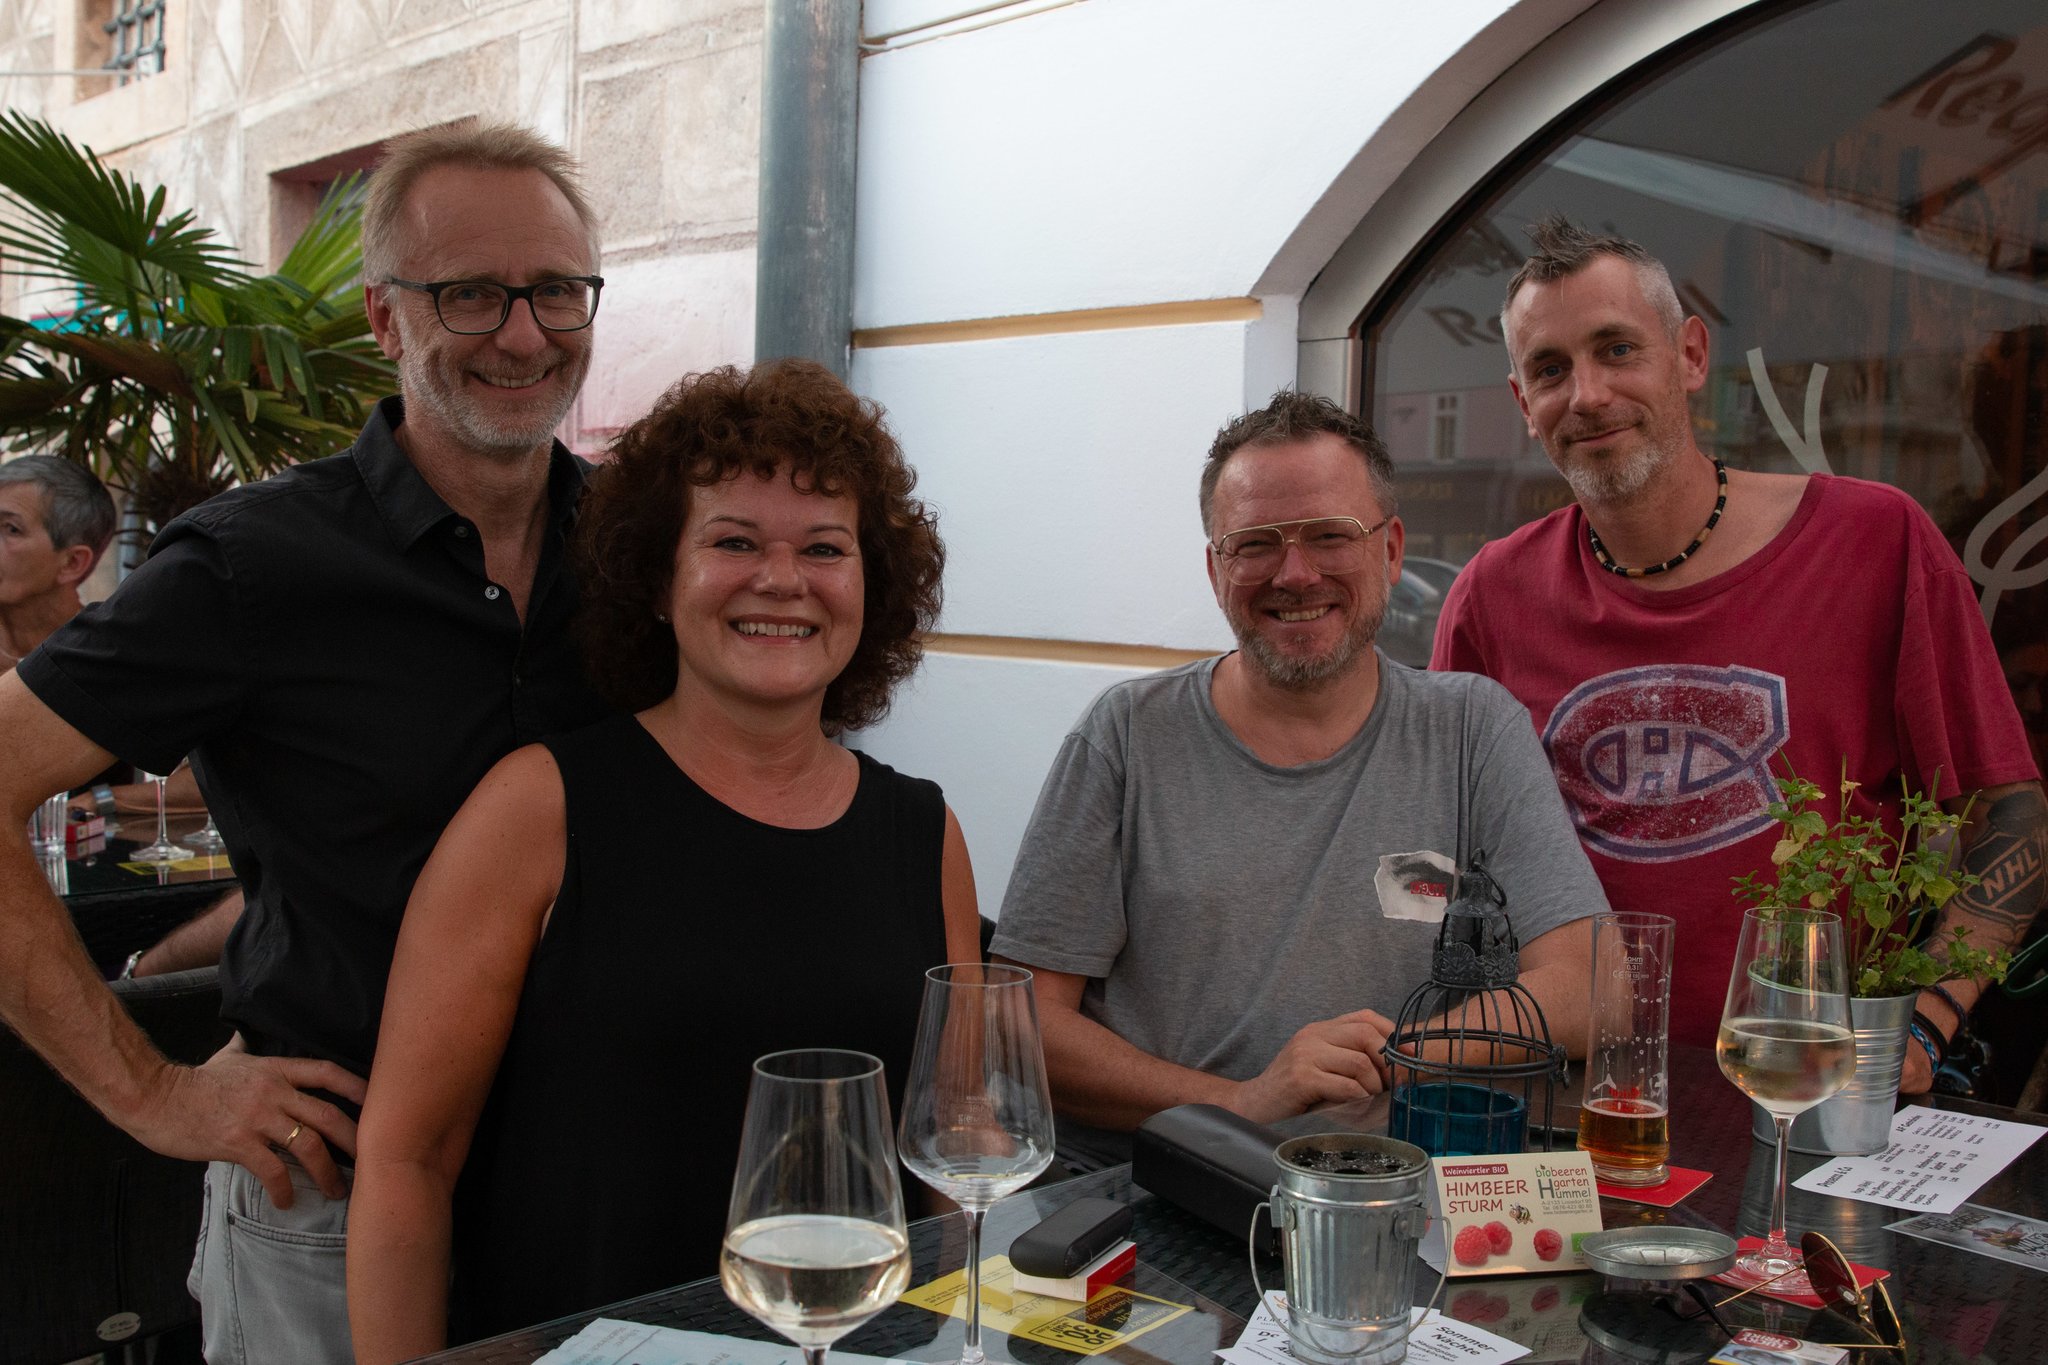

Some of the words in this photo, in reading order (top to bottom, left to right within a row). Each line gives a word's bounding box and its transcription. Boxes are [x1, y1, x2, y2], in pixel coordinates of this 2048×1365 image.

[1983, 847, 2039, 899] NHL
[1445, 1166, 1490, 1175] Weinviertler
[1492, 1165, 1506, 1173] BIO
[1535, 1166, 1587, 1177] biobeeren
[1446, 1180, 1529, 1197] HIMBEER
[1538, 1178, 1591, 1199] Hummel
[1553, 1177, 1589, 1190] garten
[1448, 1199, 1503, 1214] STURM
[1739, 1335, 1784, 1349] LUCKY
[1742, 1332, 1791, 1345] STRIKE
